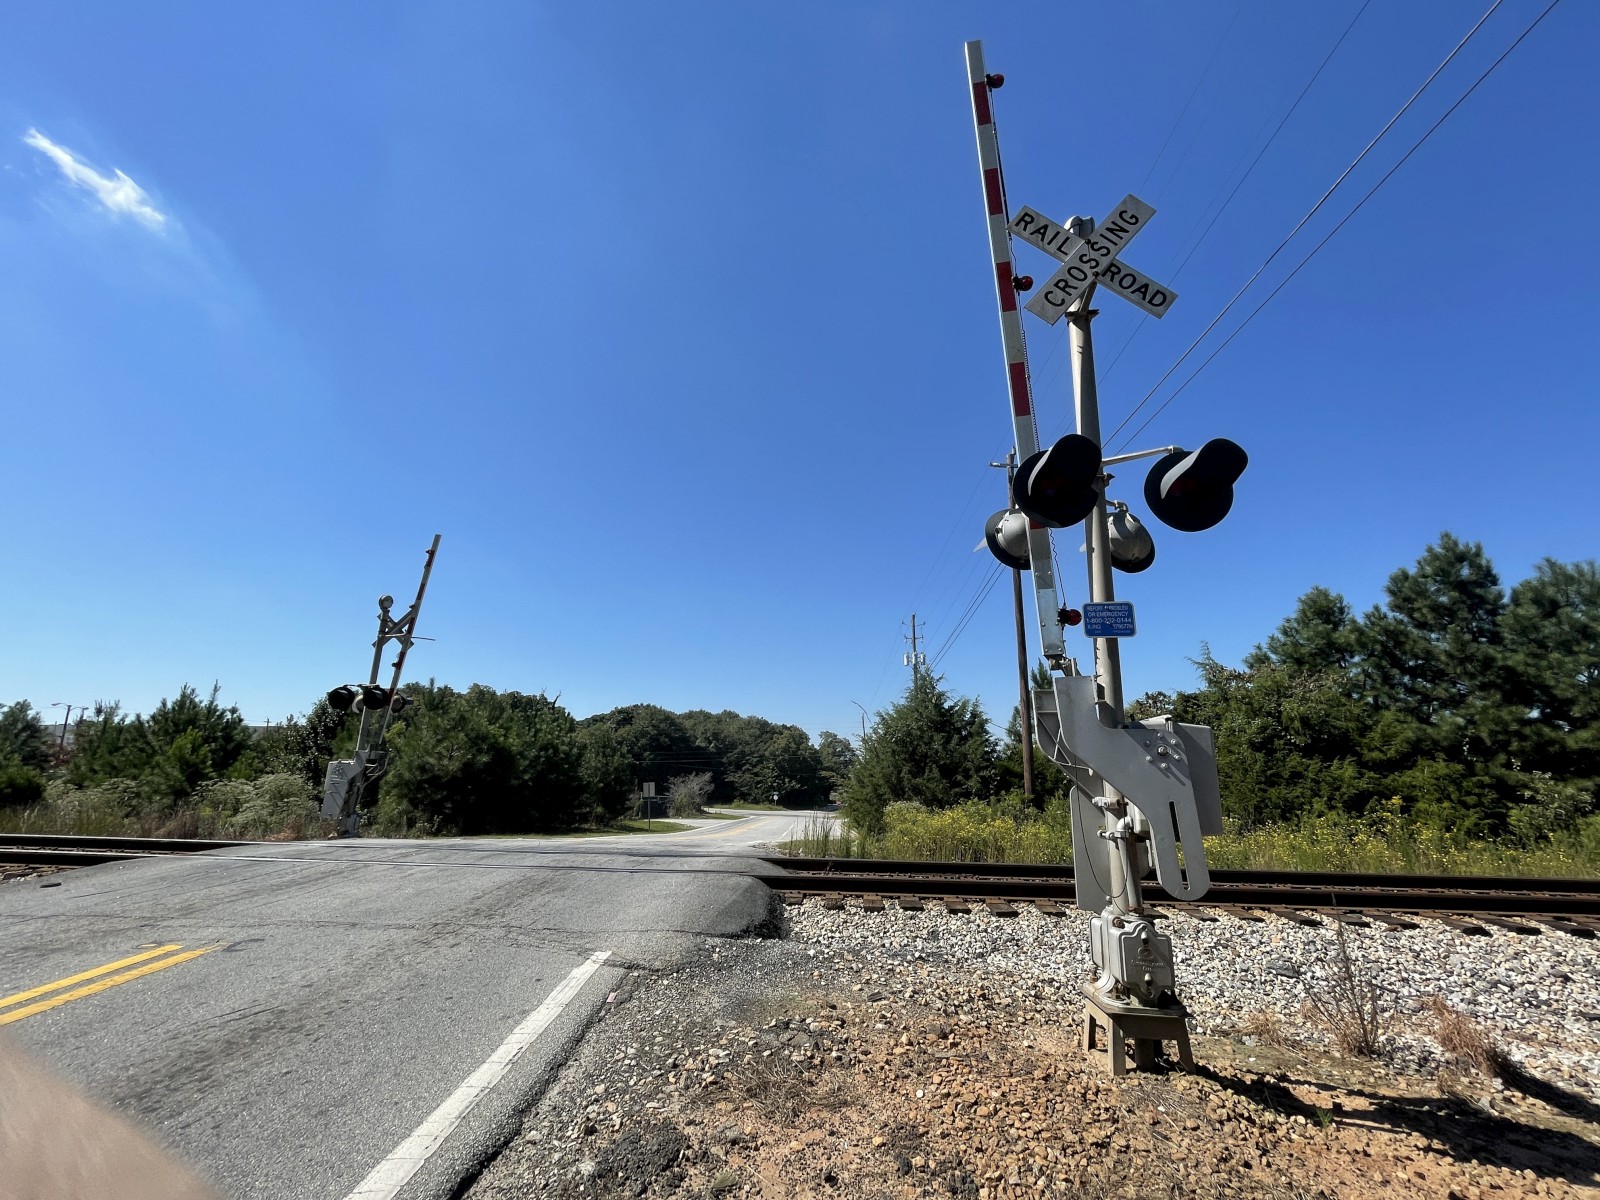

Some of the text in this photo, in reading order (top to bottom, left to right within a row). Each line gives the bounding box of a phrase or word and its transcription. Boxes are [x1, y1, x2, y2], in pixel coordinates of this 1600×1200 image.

[1014, 212, 1167, 307] RAIL ROAD
[1044, 210, 1139, 308] CROSSING
